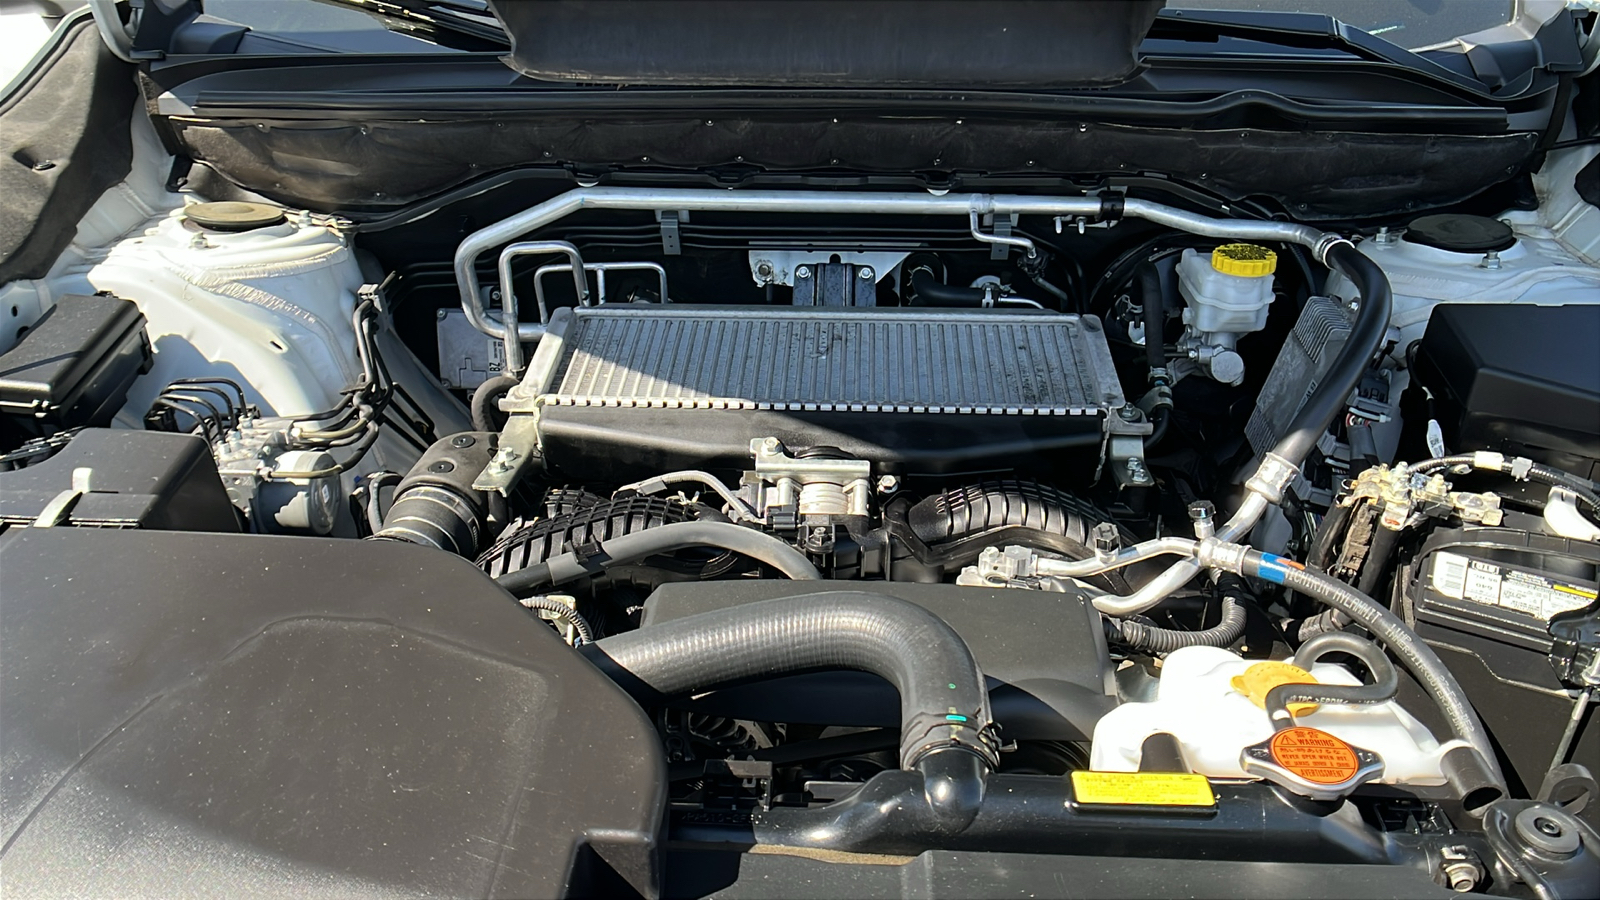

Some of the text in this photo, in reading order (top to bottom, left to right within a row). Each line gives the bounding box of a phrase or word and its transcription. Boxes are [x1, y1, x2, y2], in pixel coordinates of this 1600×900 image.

[489, 362, 501, 372] BZ
[1098, 525, 1115, 538] H
[1332, 588, 1383, 624] HYLAMMIT
[1297, 738, 1335, 747] WARNING
